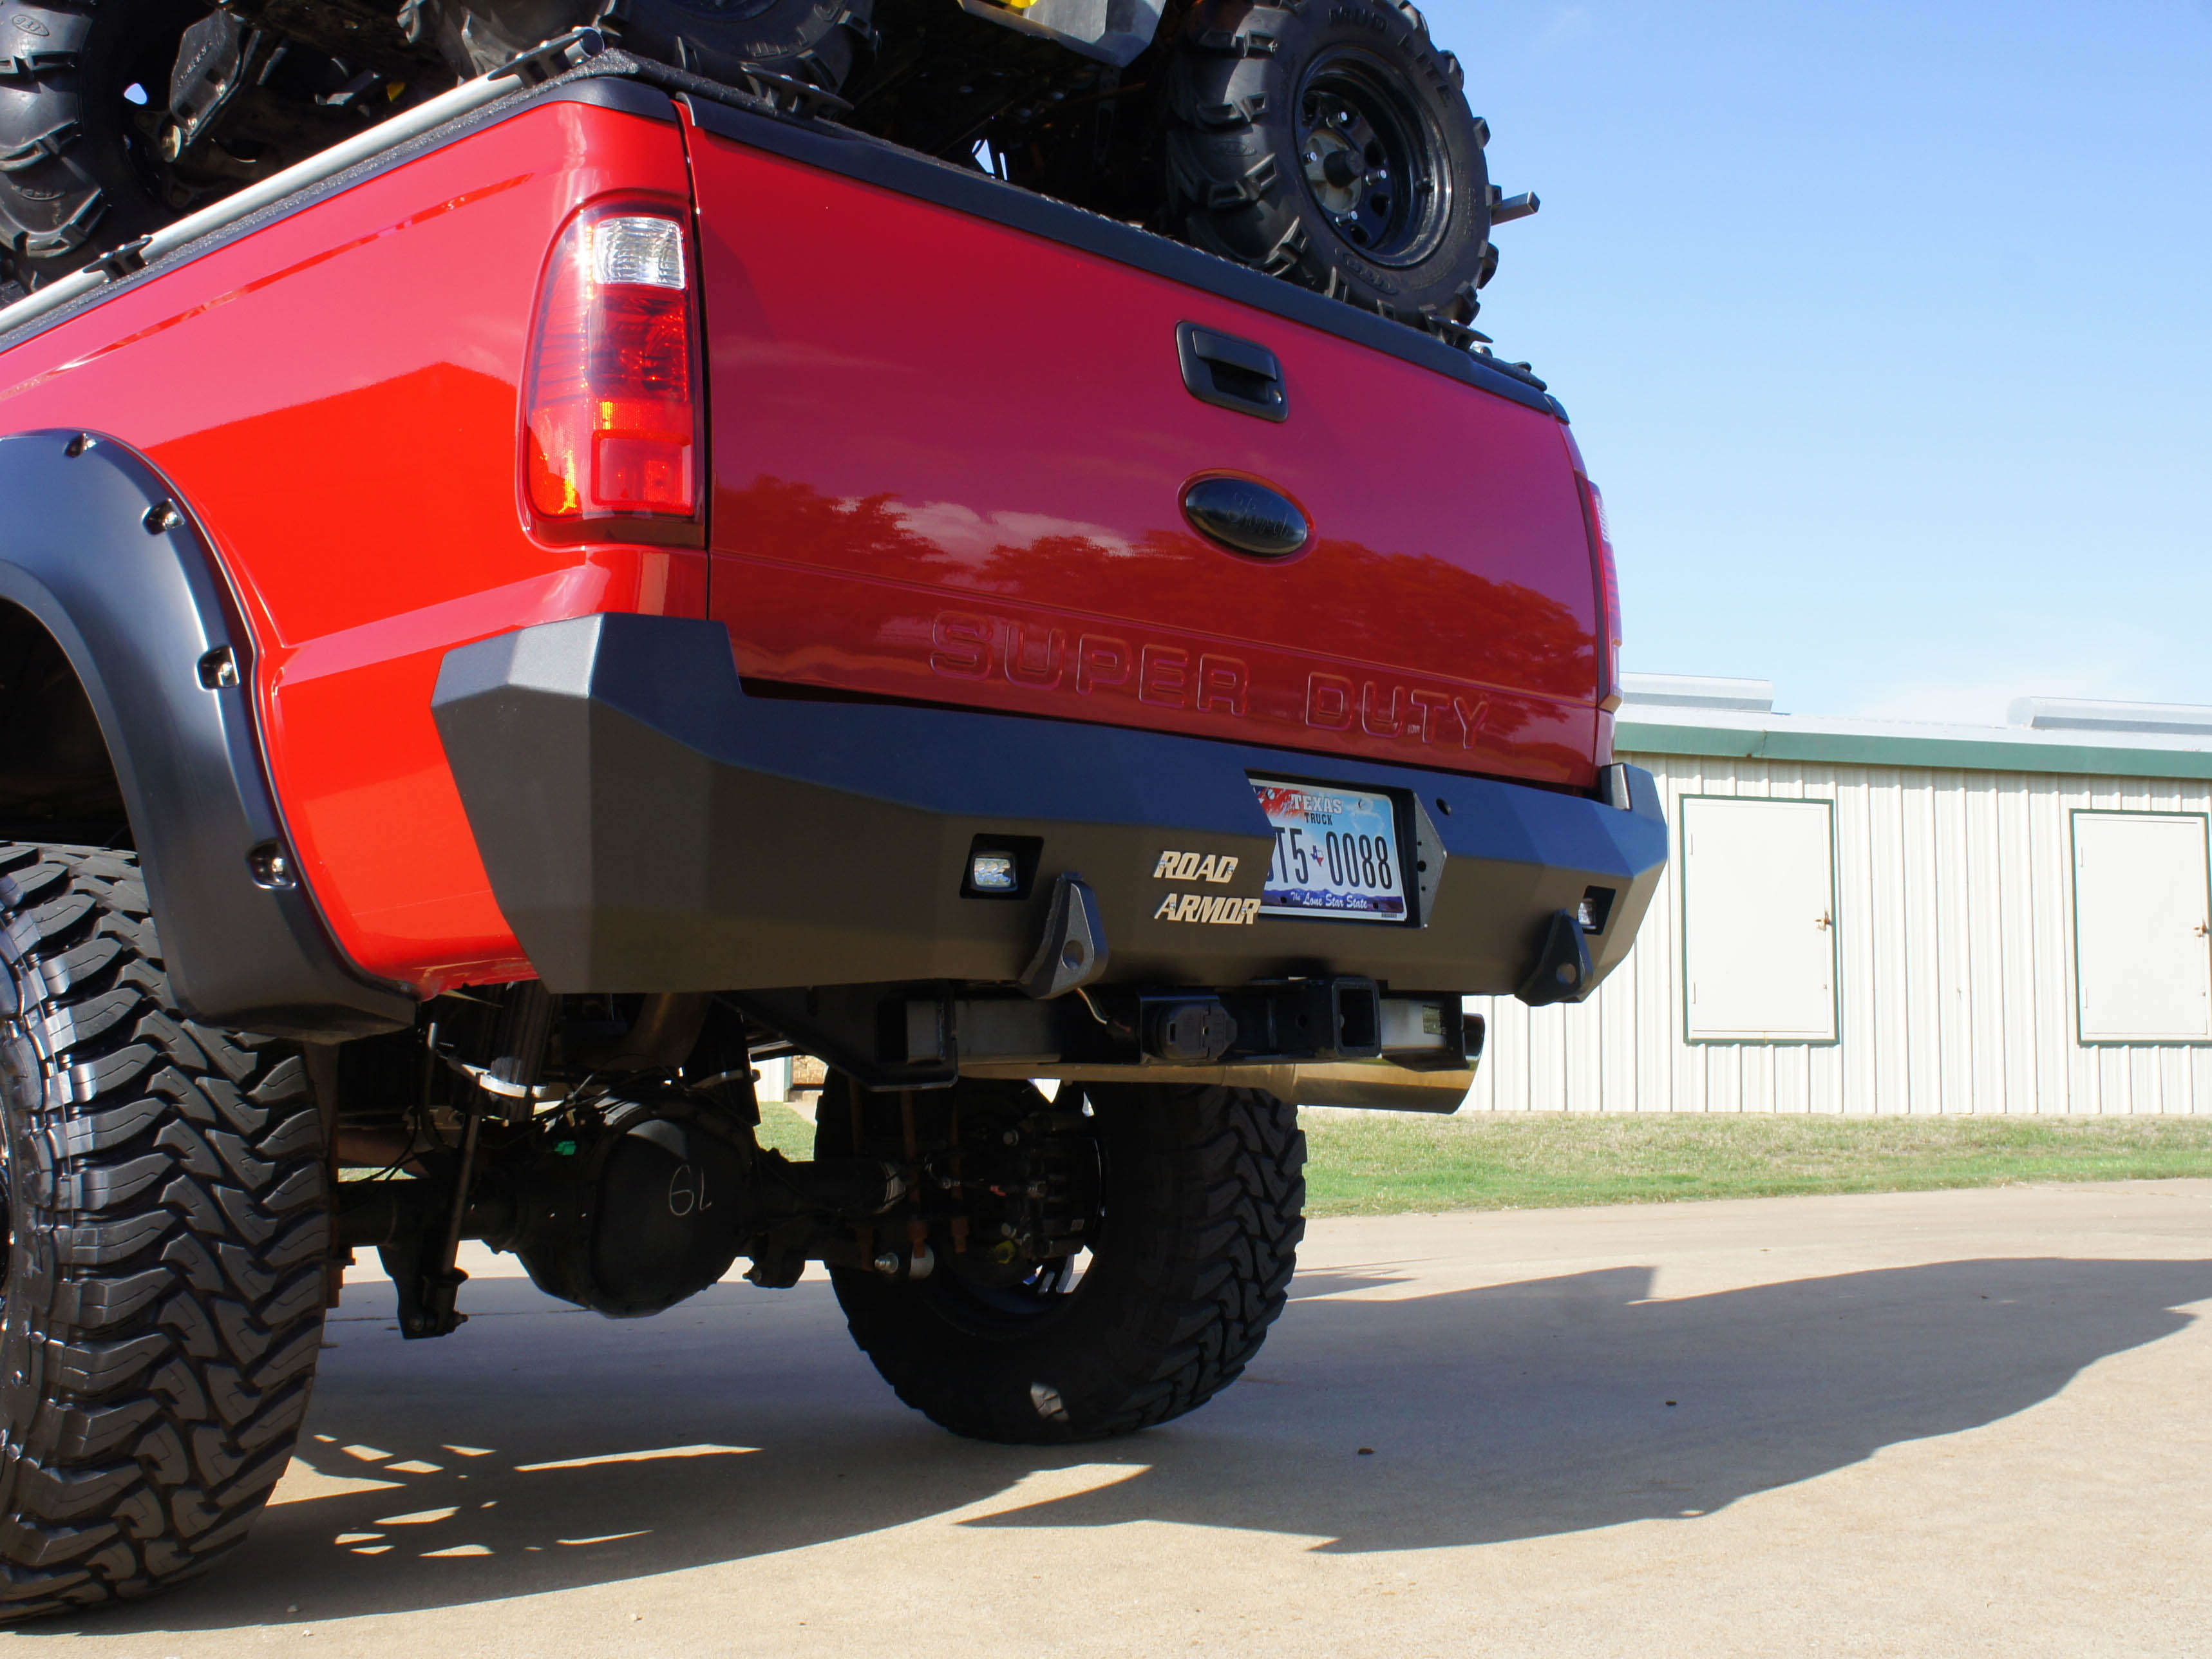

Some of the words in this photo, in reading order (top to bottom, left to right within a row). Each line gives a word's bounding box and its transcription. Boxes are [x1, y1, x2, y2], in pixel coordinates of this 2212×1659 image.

[929, 610, 1250, 717] SUPER
[1305, 671, 1489, 750] DUTY
[1290, 793, 1343, 815] TEXAS
[1304, 812, 1332, 826] TRUCK
[1153, 851, 1239, 884] ROAD
[1266, 826, 1309, 884] T5
[1326, 831, 1392, 889] 0088
[1154, 893, 1262, 925] ARMOR
[1303, 892, 1323, 905] Lone
[1325, 893, 1345, 907] Star
[1346, 895, 1368, 909] State
